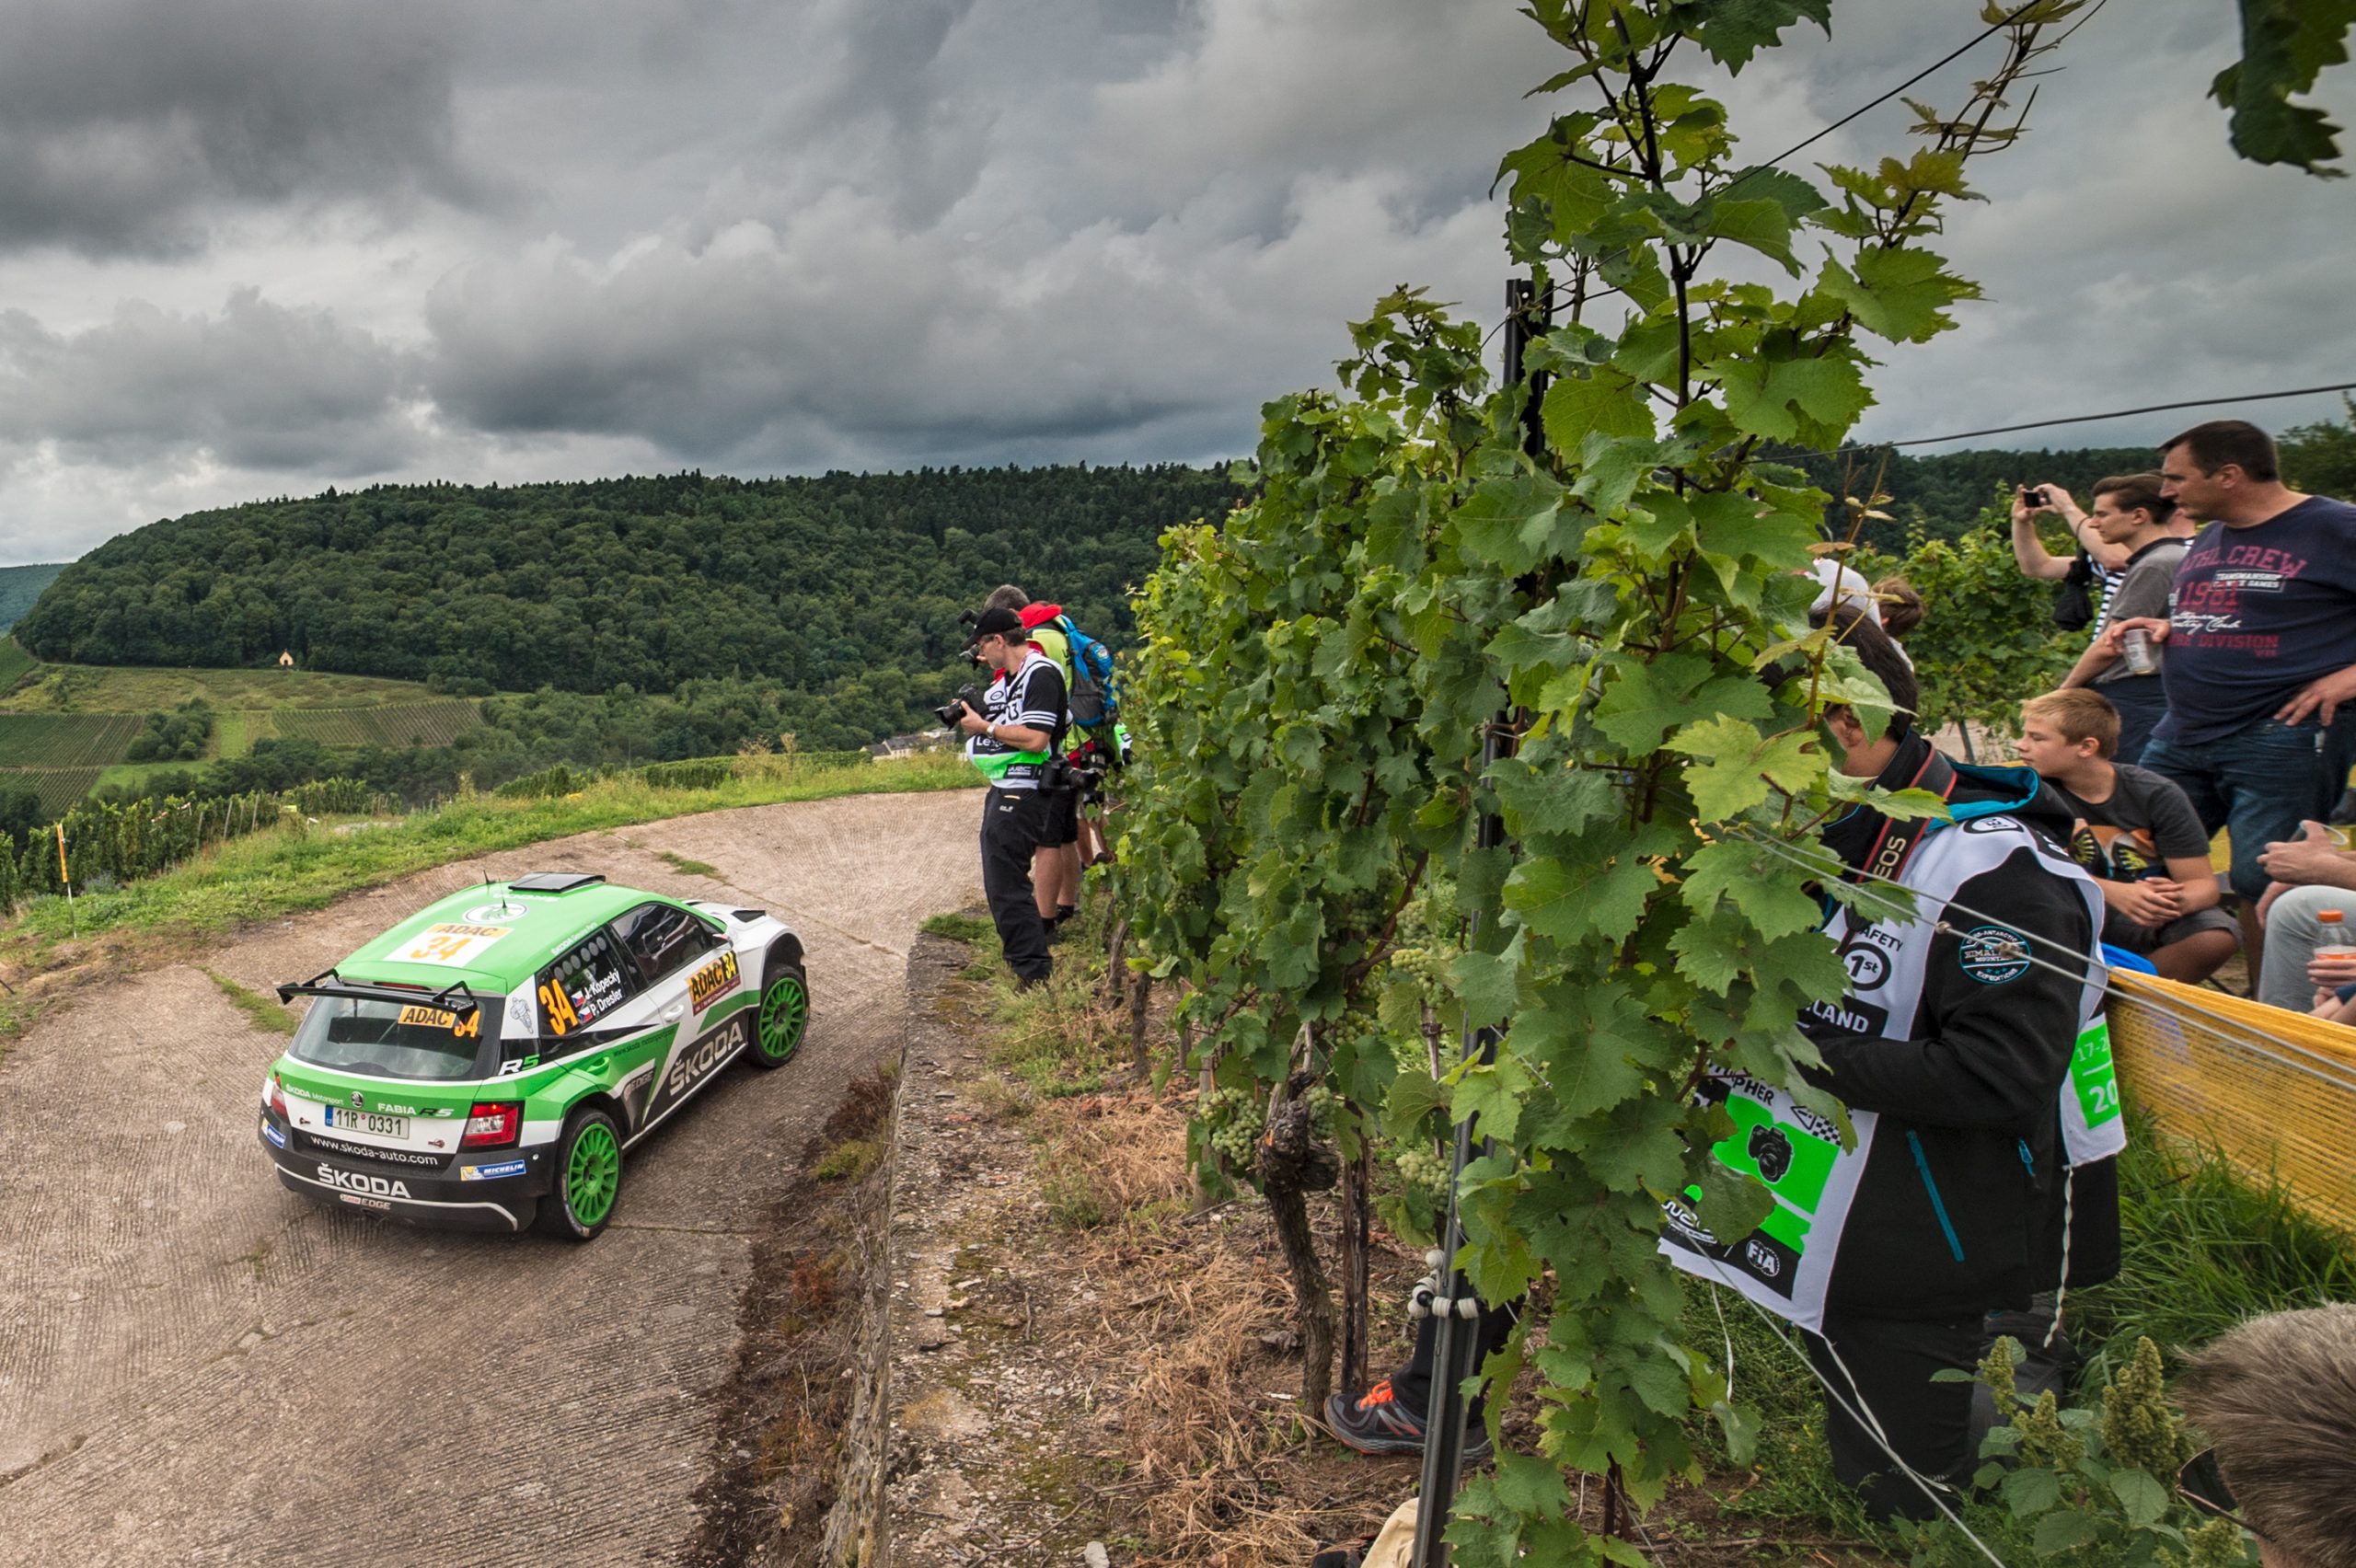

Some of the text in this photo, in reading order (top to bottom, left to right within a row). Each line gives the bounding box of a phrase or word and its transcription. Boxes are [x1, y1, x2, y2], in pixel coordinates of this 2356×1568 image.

[1874, 836, 1907, 880] EOS
[436, 924, 499, 938] ADAC
[1859, 927, 1904, 951] AFETY
[410, 936, 473, 961] 34
[690, 963, 723, 1002] ADAC
[722, 951, 736, 980] 34
[1851, 955, 1879, 976] 1st
[591, 968, 621, 993] Kopecký
[538, 978, 579, 1036] 34
[589, 988, 623, 1017] P. Dresler
[403, 1008, 450, 1026] ADAC
[498, 1054, 540, 1076] R5
[669, 1021, 744, 1096] ŠKODA
[377, 1102, 417, 1116] FABIA
[336, 1110, 358, 1129] 11R
[368, 1114, 401, 1136] 0331
[310, 1135, 439, 1166] www.skoda-auto.com
[317, 1162, 412, 1199] ŠKODA
[483, 1161, 525, 1176] MICHELIN
[361, 1197, 392, 1211] EDGE
